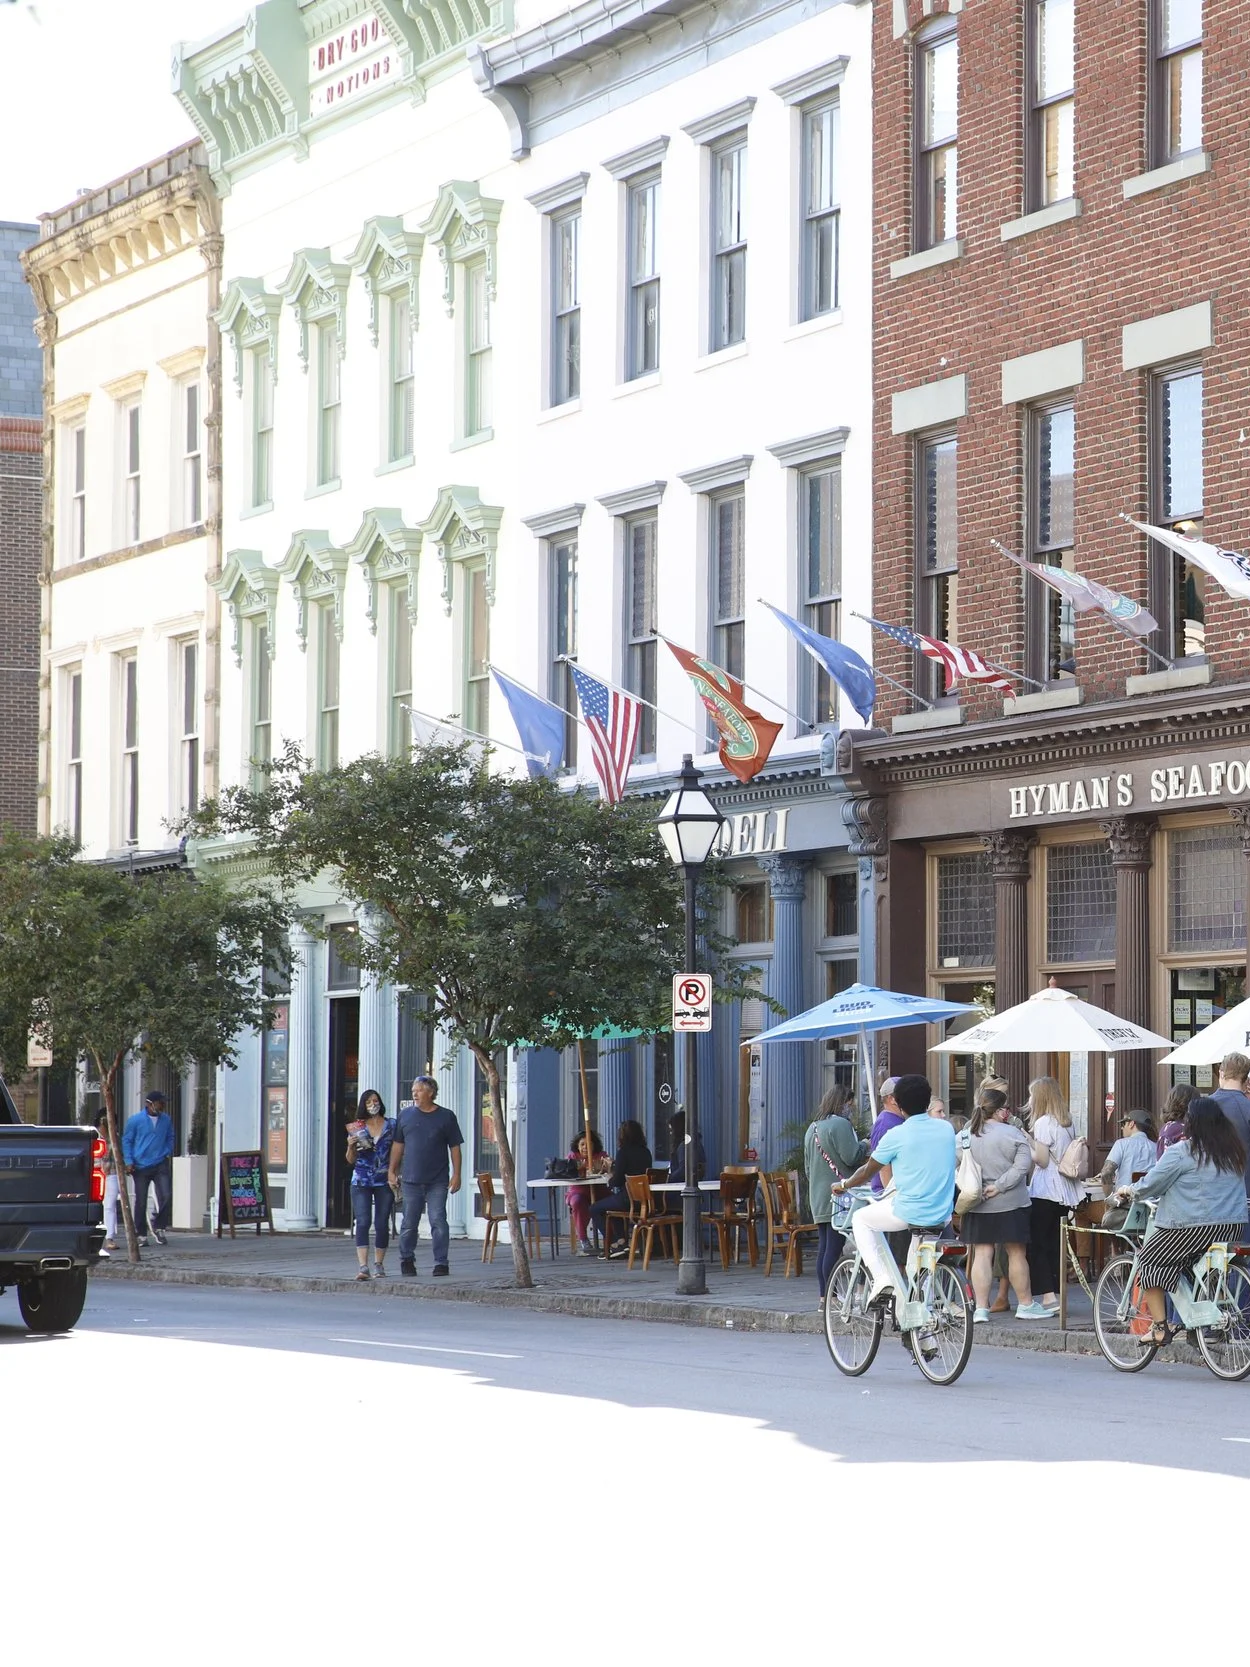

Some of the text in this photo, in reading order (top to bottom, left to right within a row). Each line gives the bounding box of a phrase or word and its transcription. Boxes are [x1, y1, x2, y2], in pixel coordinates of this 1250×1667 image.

[318, 36, 344, 70] DRY
[327, 56, 390, 104] NOTIONS
[714, 696, 751, 743] SEAFOOD
[1009, 773, 1134, 819] HYMANS
[712, 807, 791, 857] DELI
[832, 1004, 875, 1014] LIGHT
[839, 1001, 872, 1009] BUD
[1098, 1027, 1140, 1042] FIREFLY
